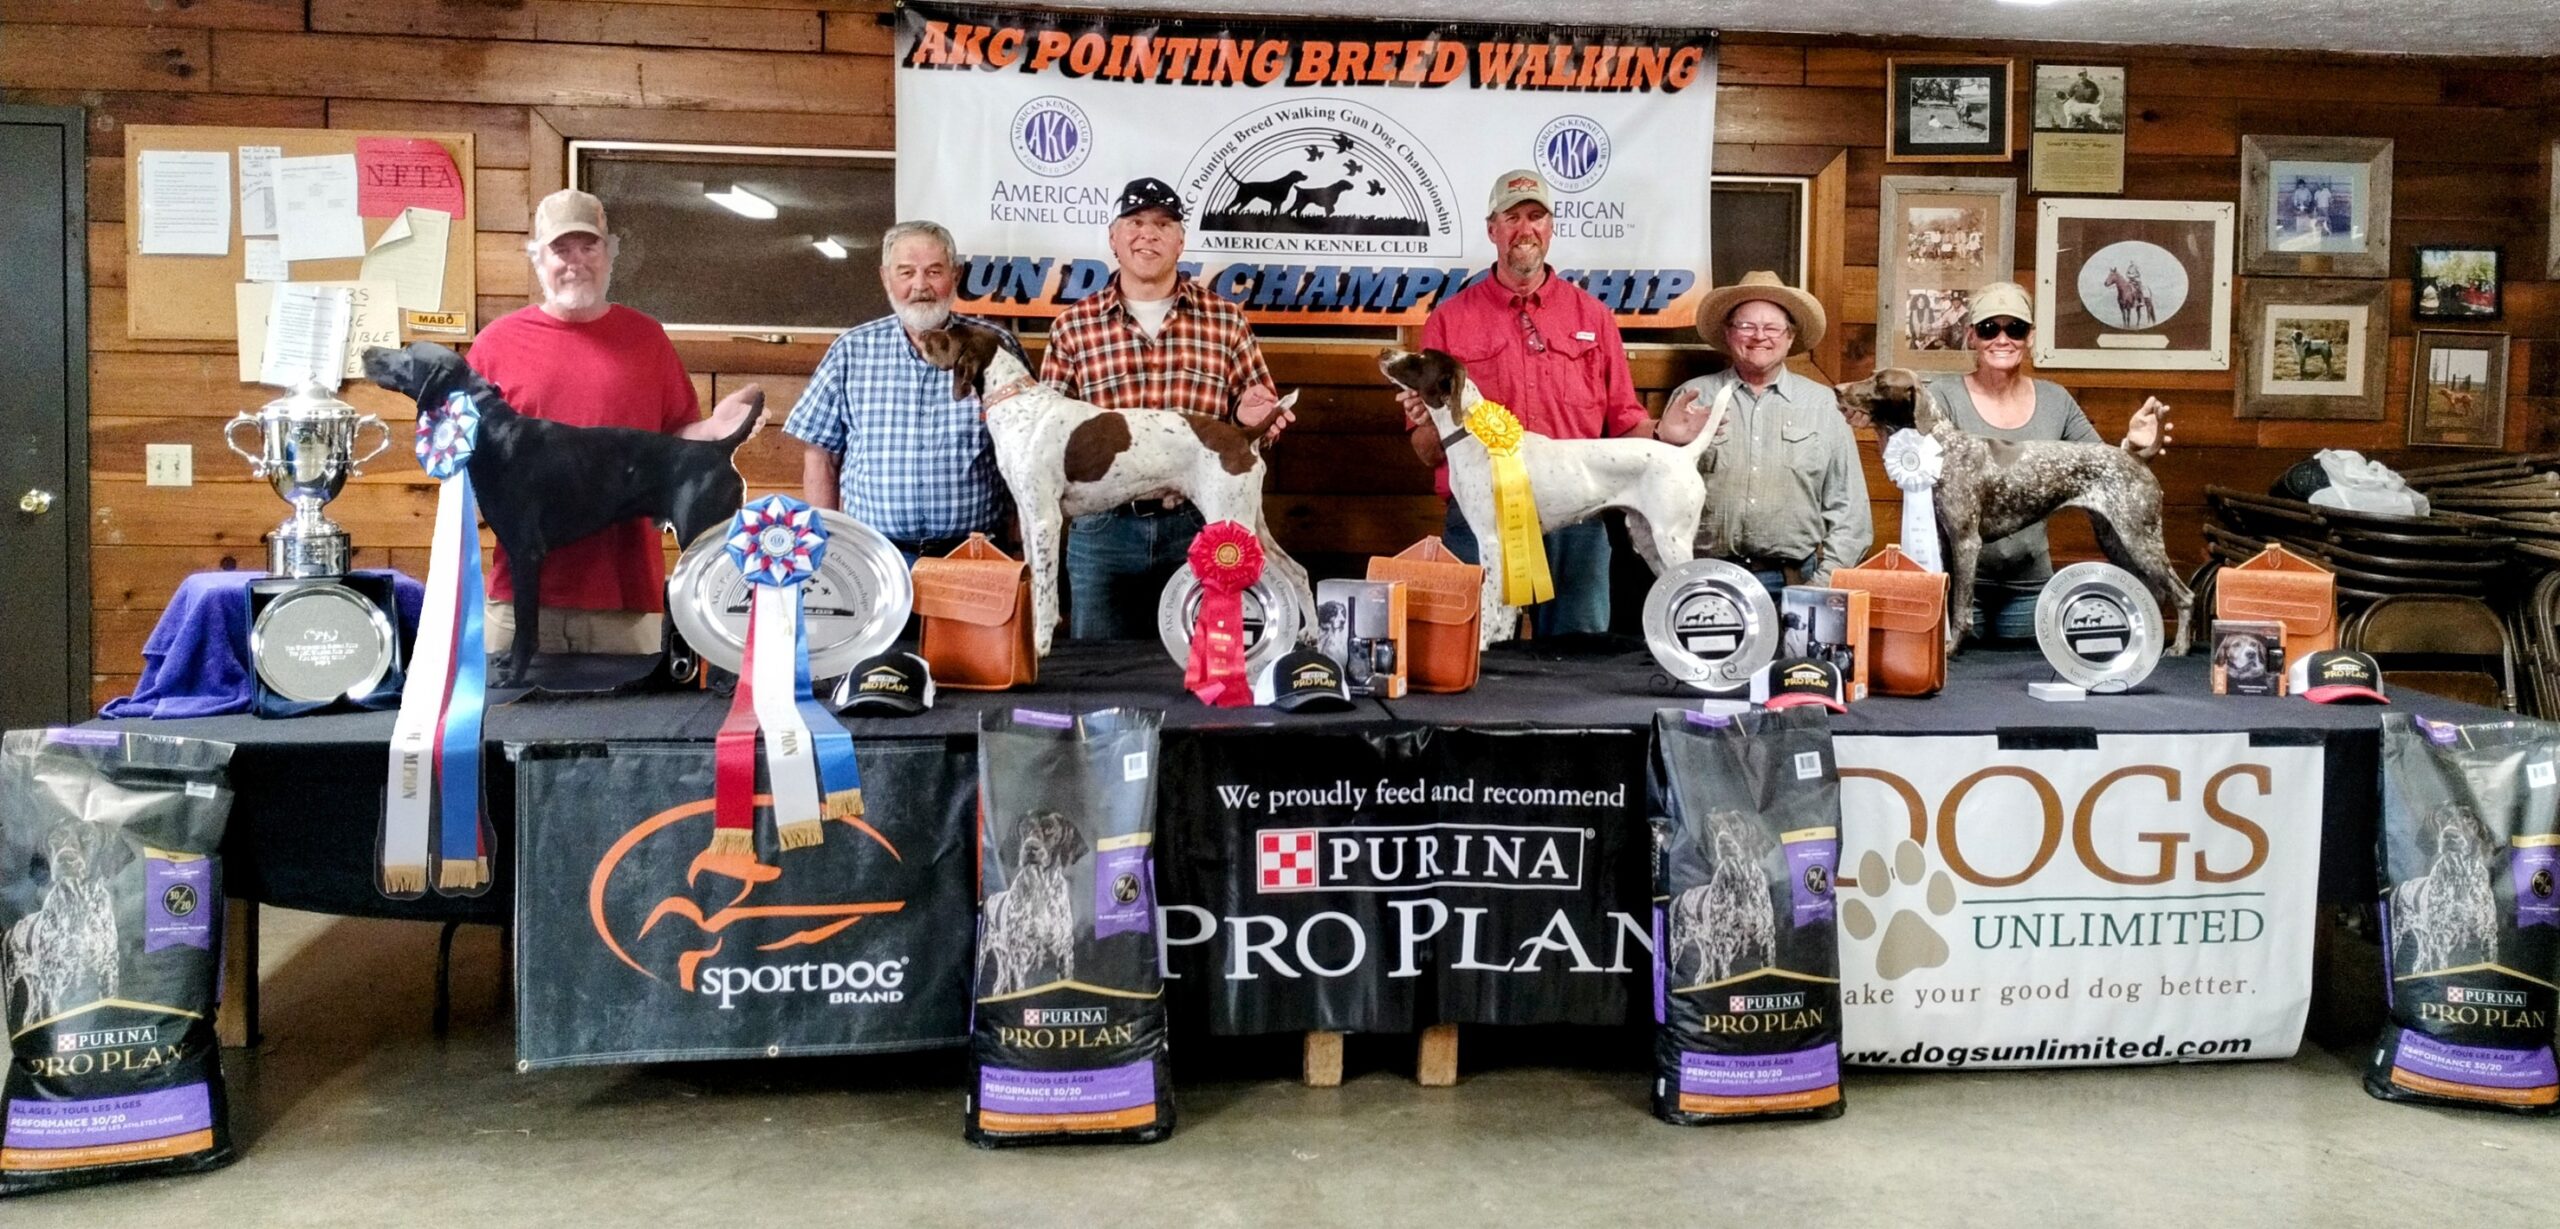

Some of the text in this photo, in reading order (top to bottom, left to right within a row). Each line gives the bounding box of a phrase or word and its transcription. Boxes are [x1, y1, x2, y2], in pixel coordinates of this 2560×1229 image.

[908, 20, 1703, 92] AKC POINTING BREED WALKING
[1015, 99, 1089, 144] AMERICAN KENNEL CLUB
[1028, 111, 1075, 162] AKC
[1538, 118, 1607, 160] AMERICAN KENNEL CLUB
[1551, 130, 1597, 177] AKC
[1183, 106, 1452, 235] AKC Pointing Breed Walking Gun Dog Championship
[992, 180, 1109, 206] AMERICAN
[990, 204, 1110, 225] KENNEL CLUB
[1553, 201, 1624, 219] ERICAN
[1580, 221, 1625, 239] CLUB
[1201, 236, 1429, 254] AMERICAN KENNEL CLUB
[960, 255, 1055, 300] UN
[1216, 262, 1696, 310] CHAMPIHIP
[1217, 779, 1626, 813] We proudly feed and recommend
[1836, 763, 2272, 888] DOGS
[1328, 834, 1570, 881] PURINA
[1157, 898, 1654, 981] PRO PLAN
[1972, 907, 2265, 950] UNLIMITED
[829, 991, 904, 1004] BRAND
[1747, 995, 1801, 1009] PURINA
[1843, 974, 2259, 1008] ake your good dog better.
[2466, 990, 2524, 1005] PURINA
[1041, 1011, 1103, 1024] PURINA
[1704, 1008, 1824, 1034] PRO PLAN
[2420, 1002, 2546, 1028] PRO PLAN
[79, 1028, 152, 1048] PURINA
[1001, 1023, 1133, 1048] PRO PLAN
[100, 1042, 188, 1073] PLAN
[1843, 1034, 2253, 1067] w.dogsunlimited.com
[2403, 1046, 2472, 1069] PERFORMANCE
[1686, 1067, 1755, 1079] PERFORMANCE
[1734, 1060, 1755, 1068] TOUS
[985, 1083, 1051, 1096] PERFORMANCE
[1029, 1076, 1051, 1084] TOUS
[11, 1114, 127, 1128] PERFORMANCE 30/20
[62, 1104, 91, 1114] TOUS
[92, 1103, 111, 1113] LES
